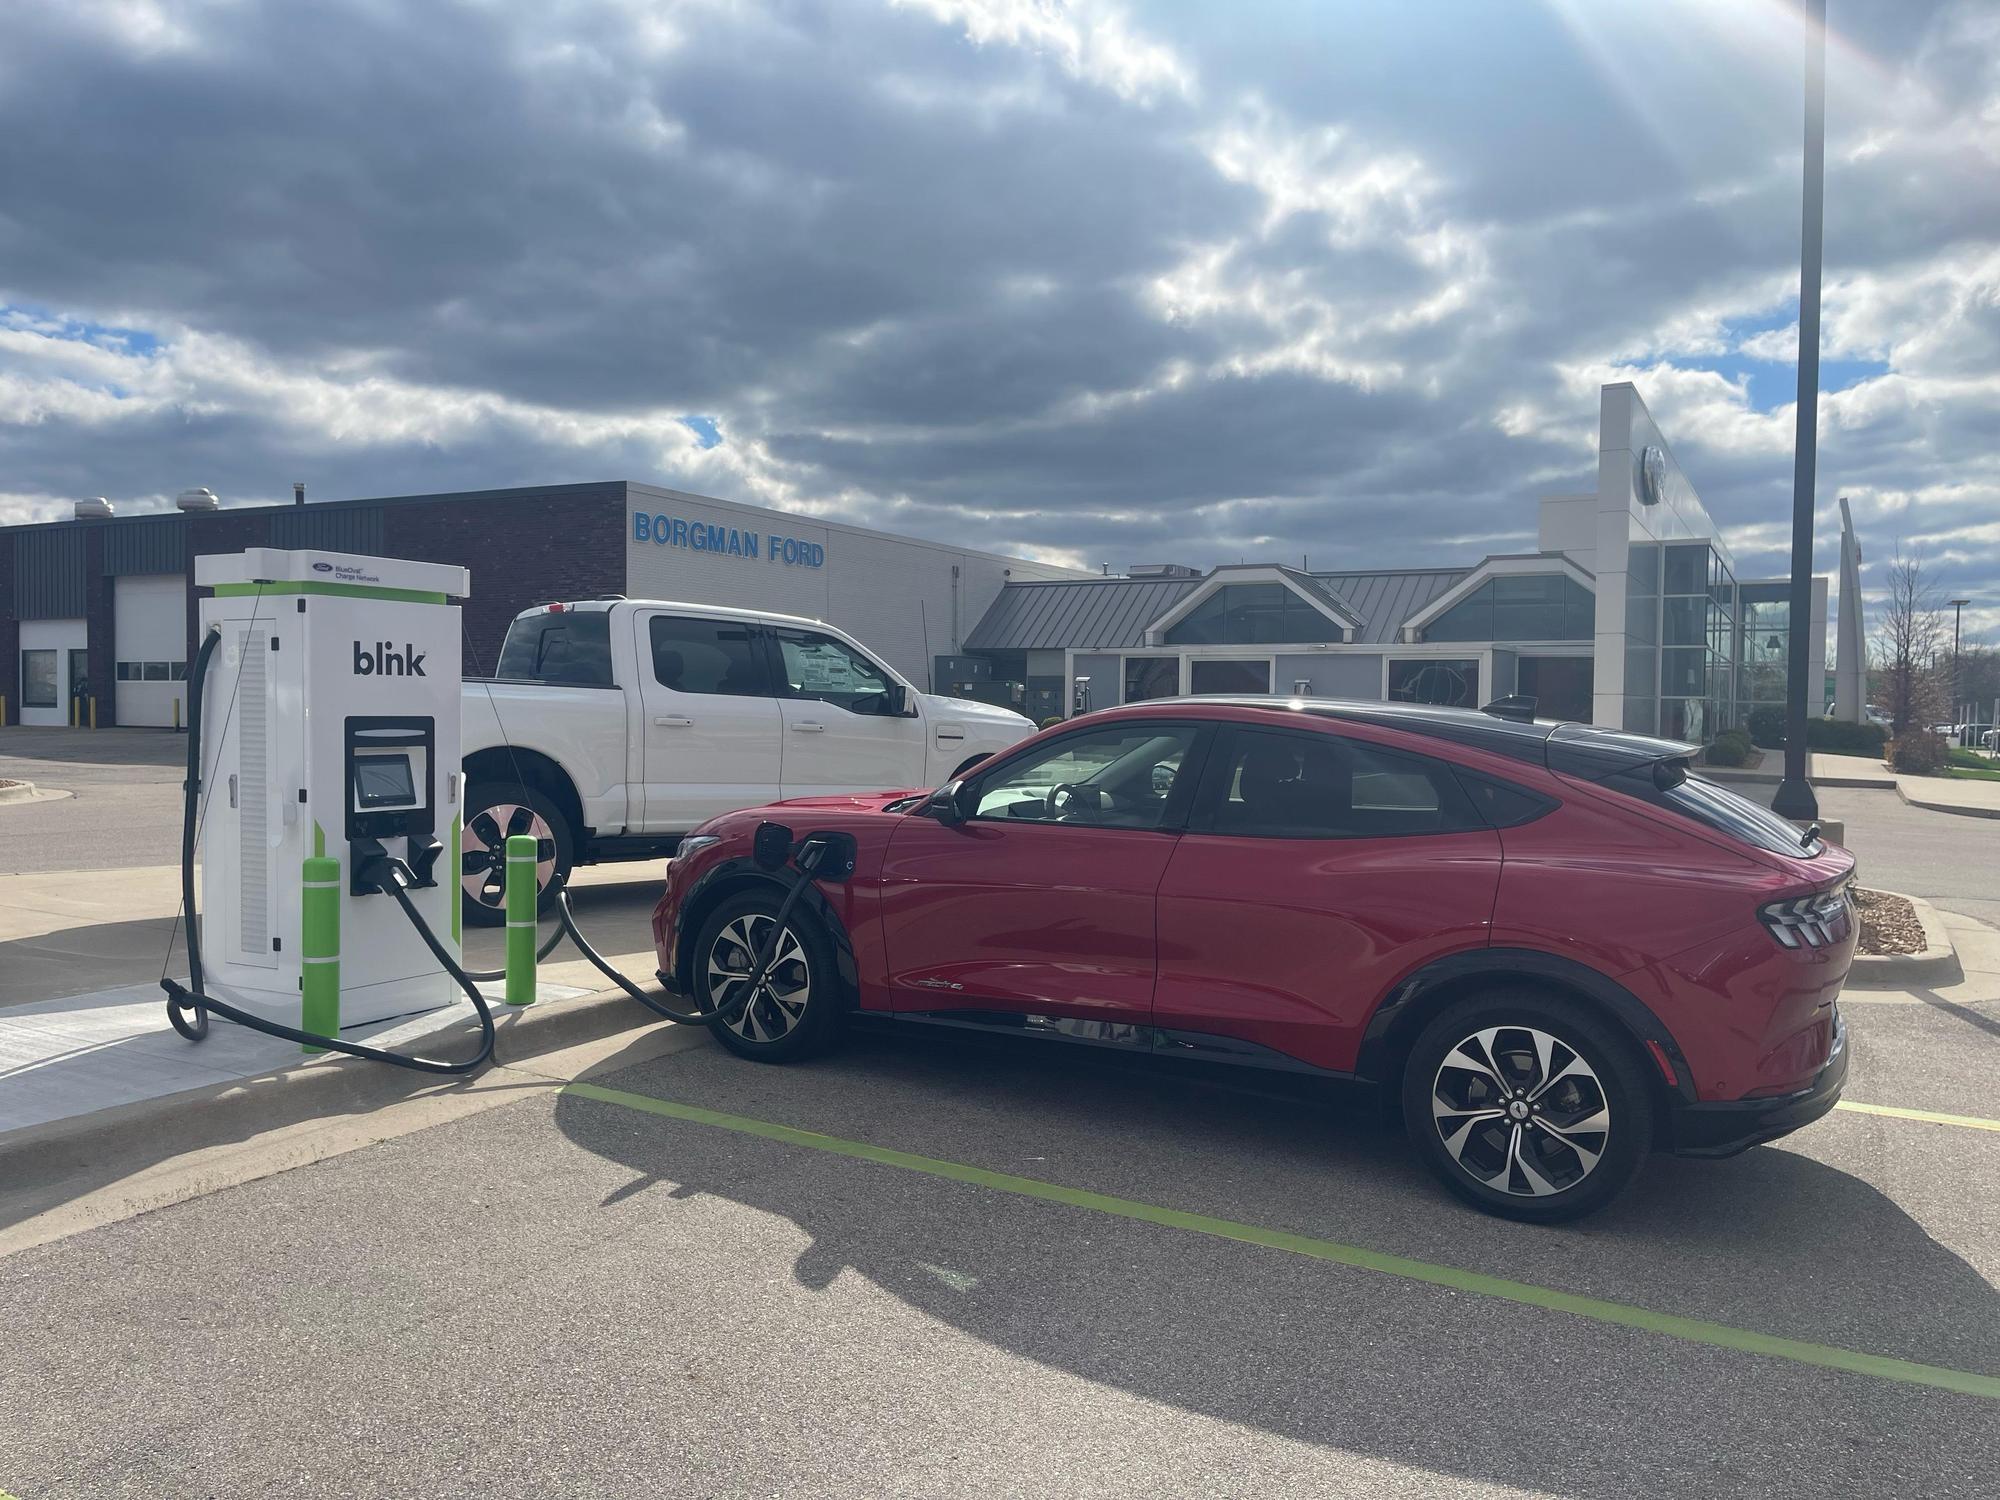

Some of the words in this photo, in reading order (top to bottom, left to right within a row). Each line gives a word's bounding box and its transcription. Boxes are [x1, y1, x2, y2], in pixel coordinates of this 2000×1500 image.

[633, 511, 759, 559] BORGMAN
[768, 534, 825, 569] FORD
[335, 572, 355, 581] Charge
[356, 573, 380, 582] Network
[353, 640, 426, 677] blink
